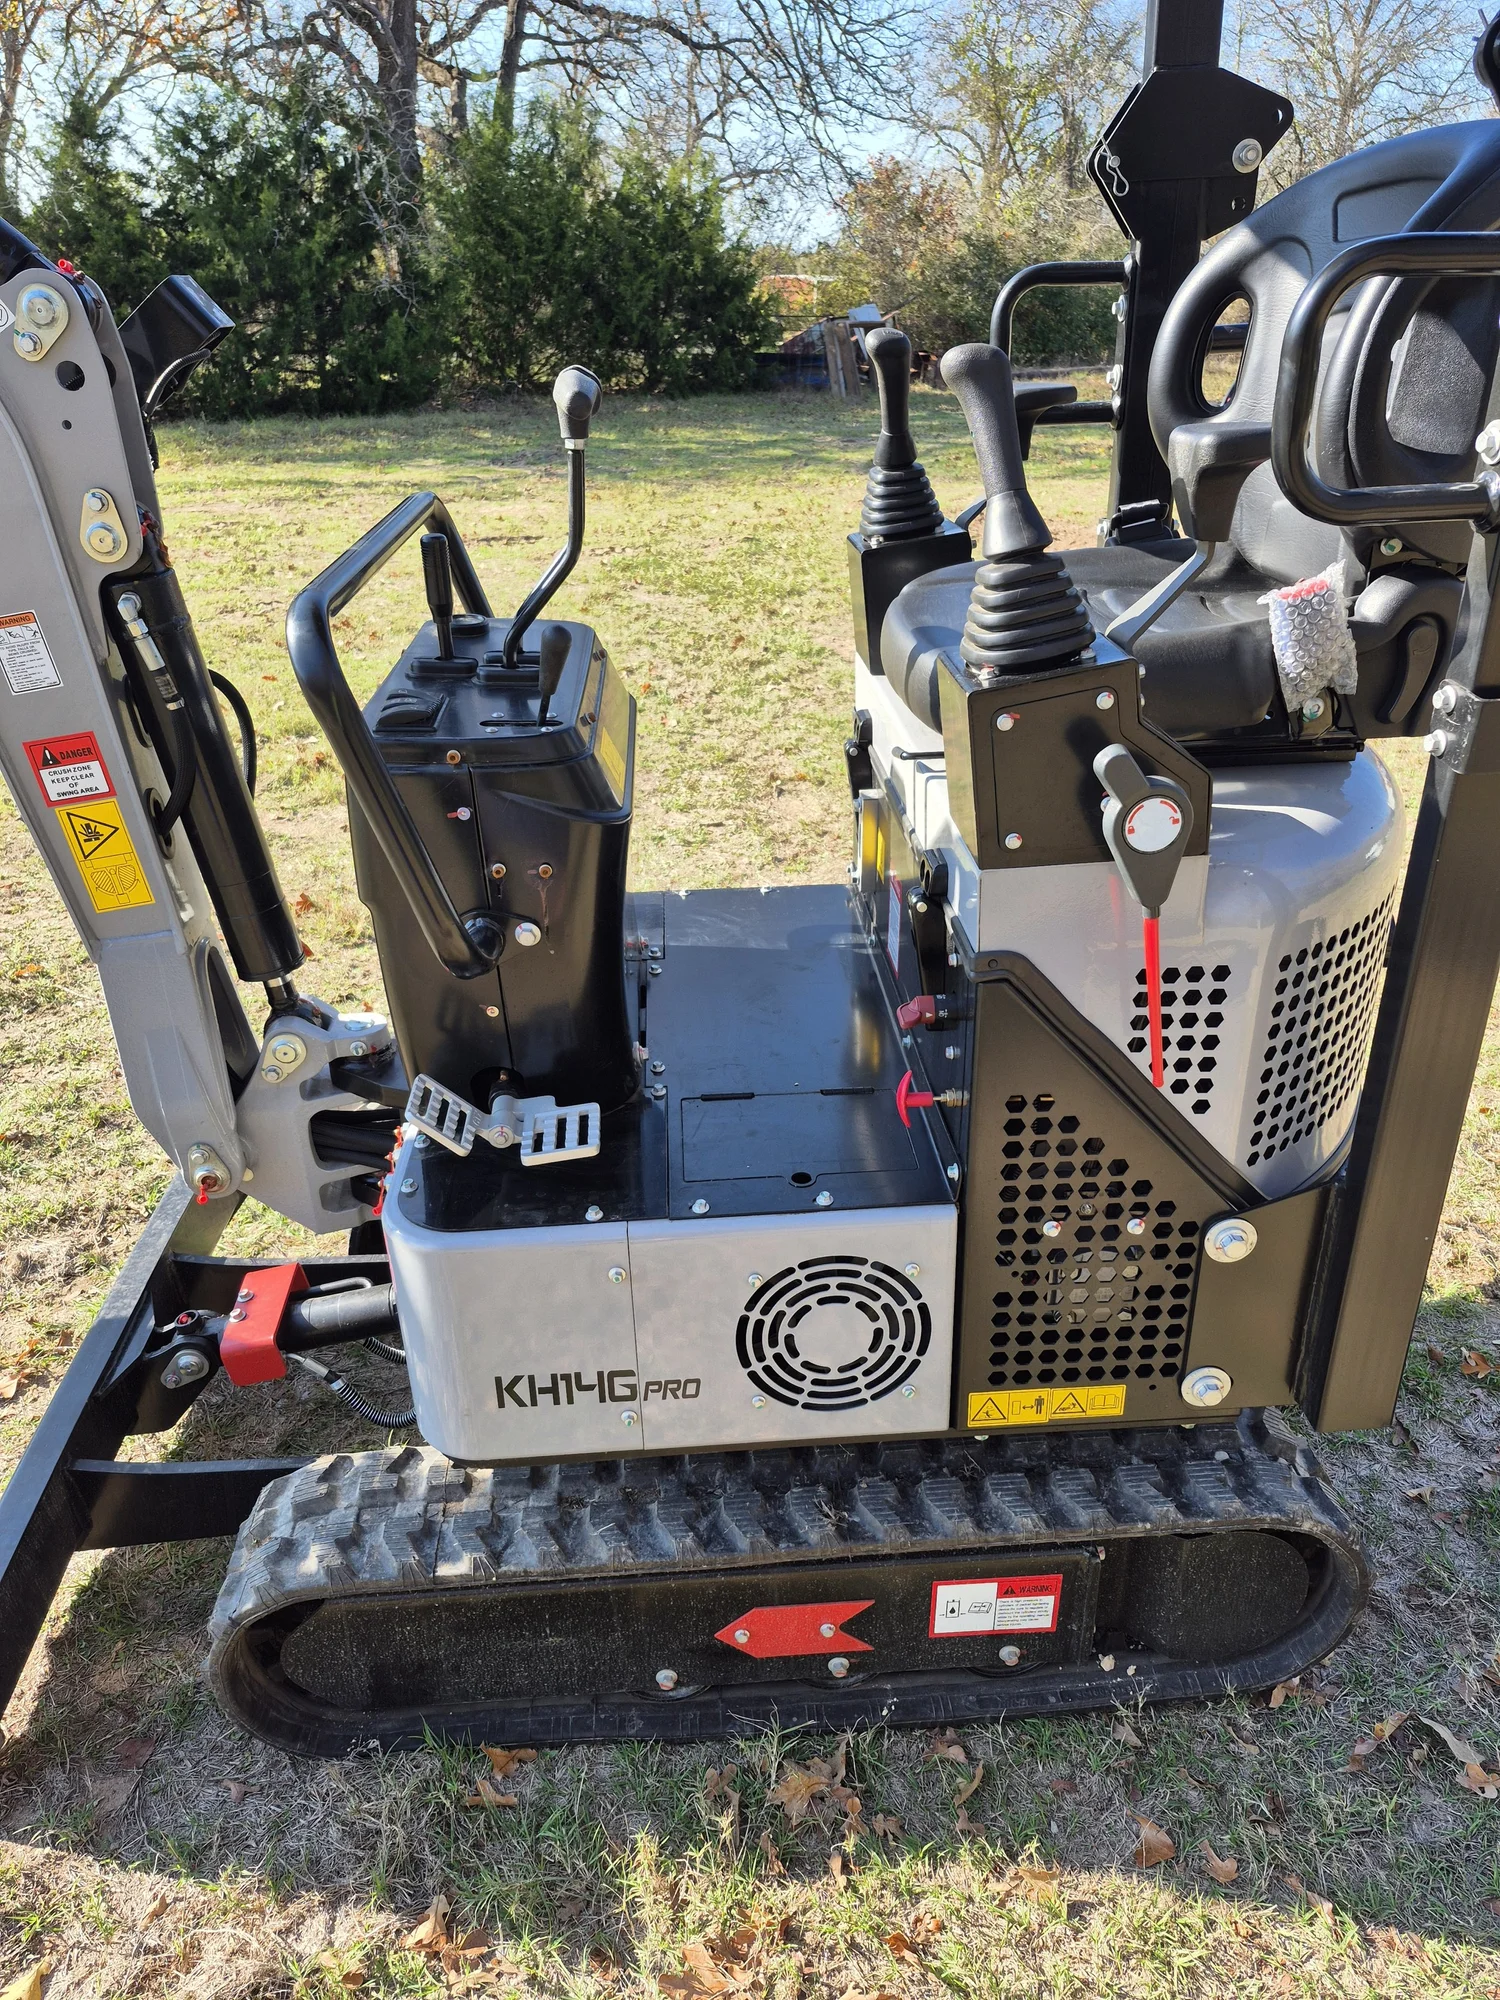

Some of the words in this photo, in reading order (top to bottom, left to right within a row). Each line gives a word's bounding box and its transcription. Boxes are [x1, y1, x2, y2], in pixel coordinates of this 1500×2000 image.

[59, 747, 93, 760] DANGER
[48, 769, 72, 777] CRUSH
[51, 776, 70, 784] KEEP
[71, 772, 95, 781] CLEAR
[56, 789, 79, 798] SWING
[80, 786, 100, 794] AREA
[494, 1369, 638, 1409] KH14G
[643, 1378, 702, 1402] PRO
[1019, 1585, 1053, 1594] WARNING
